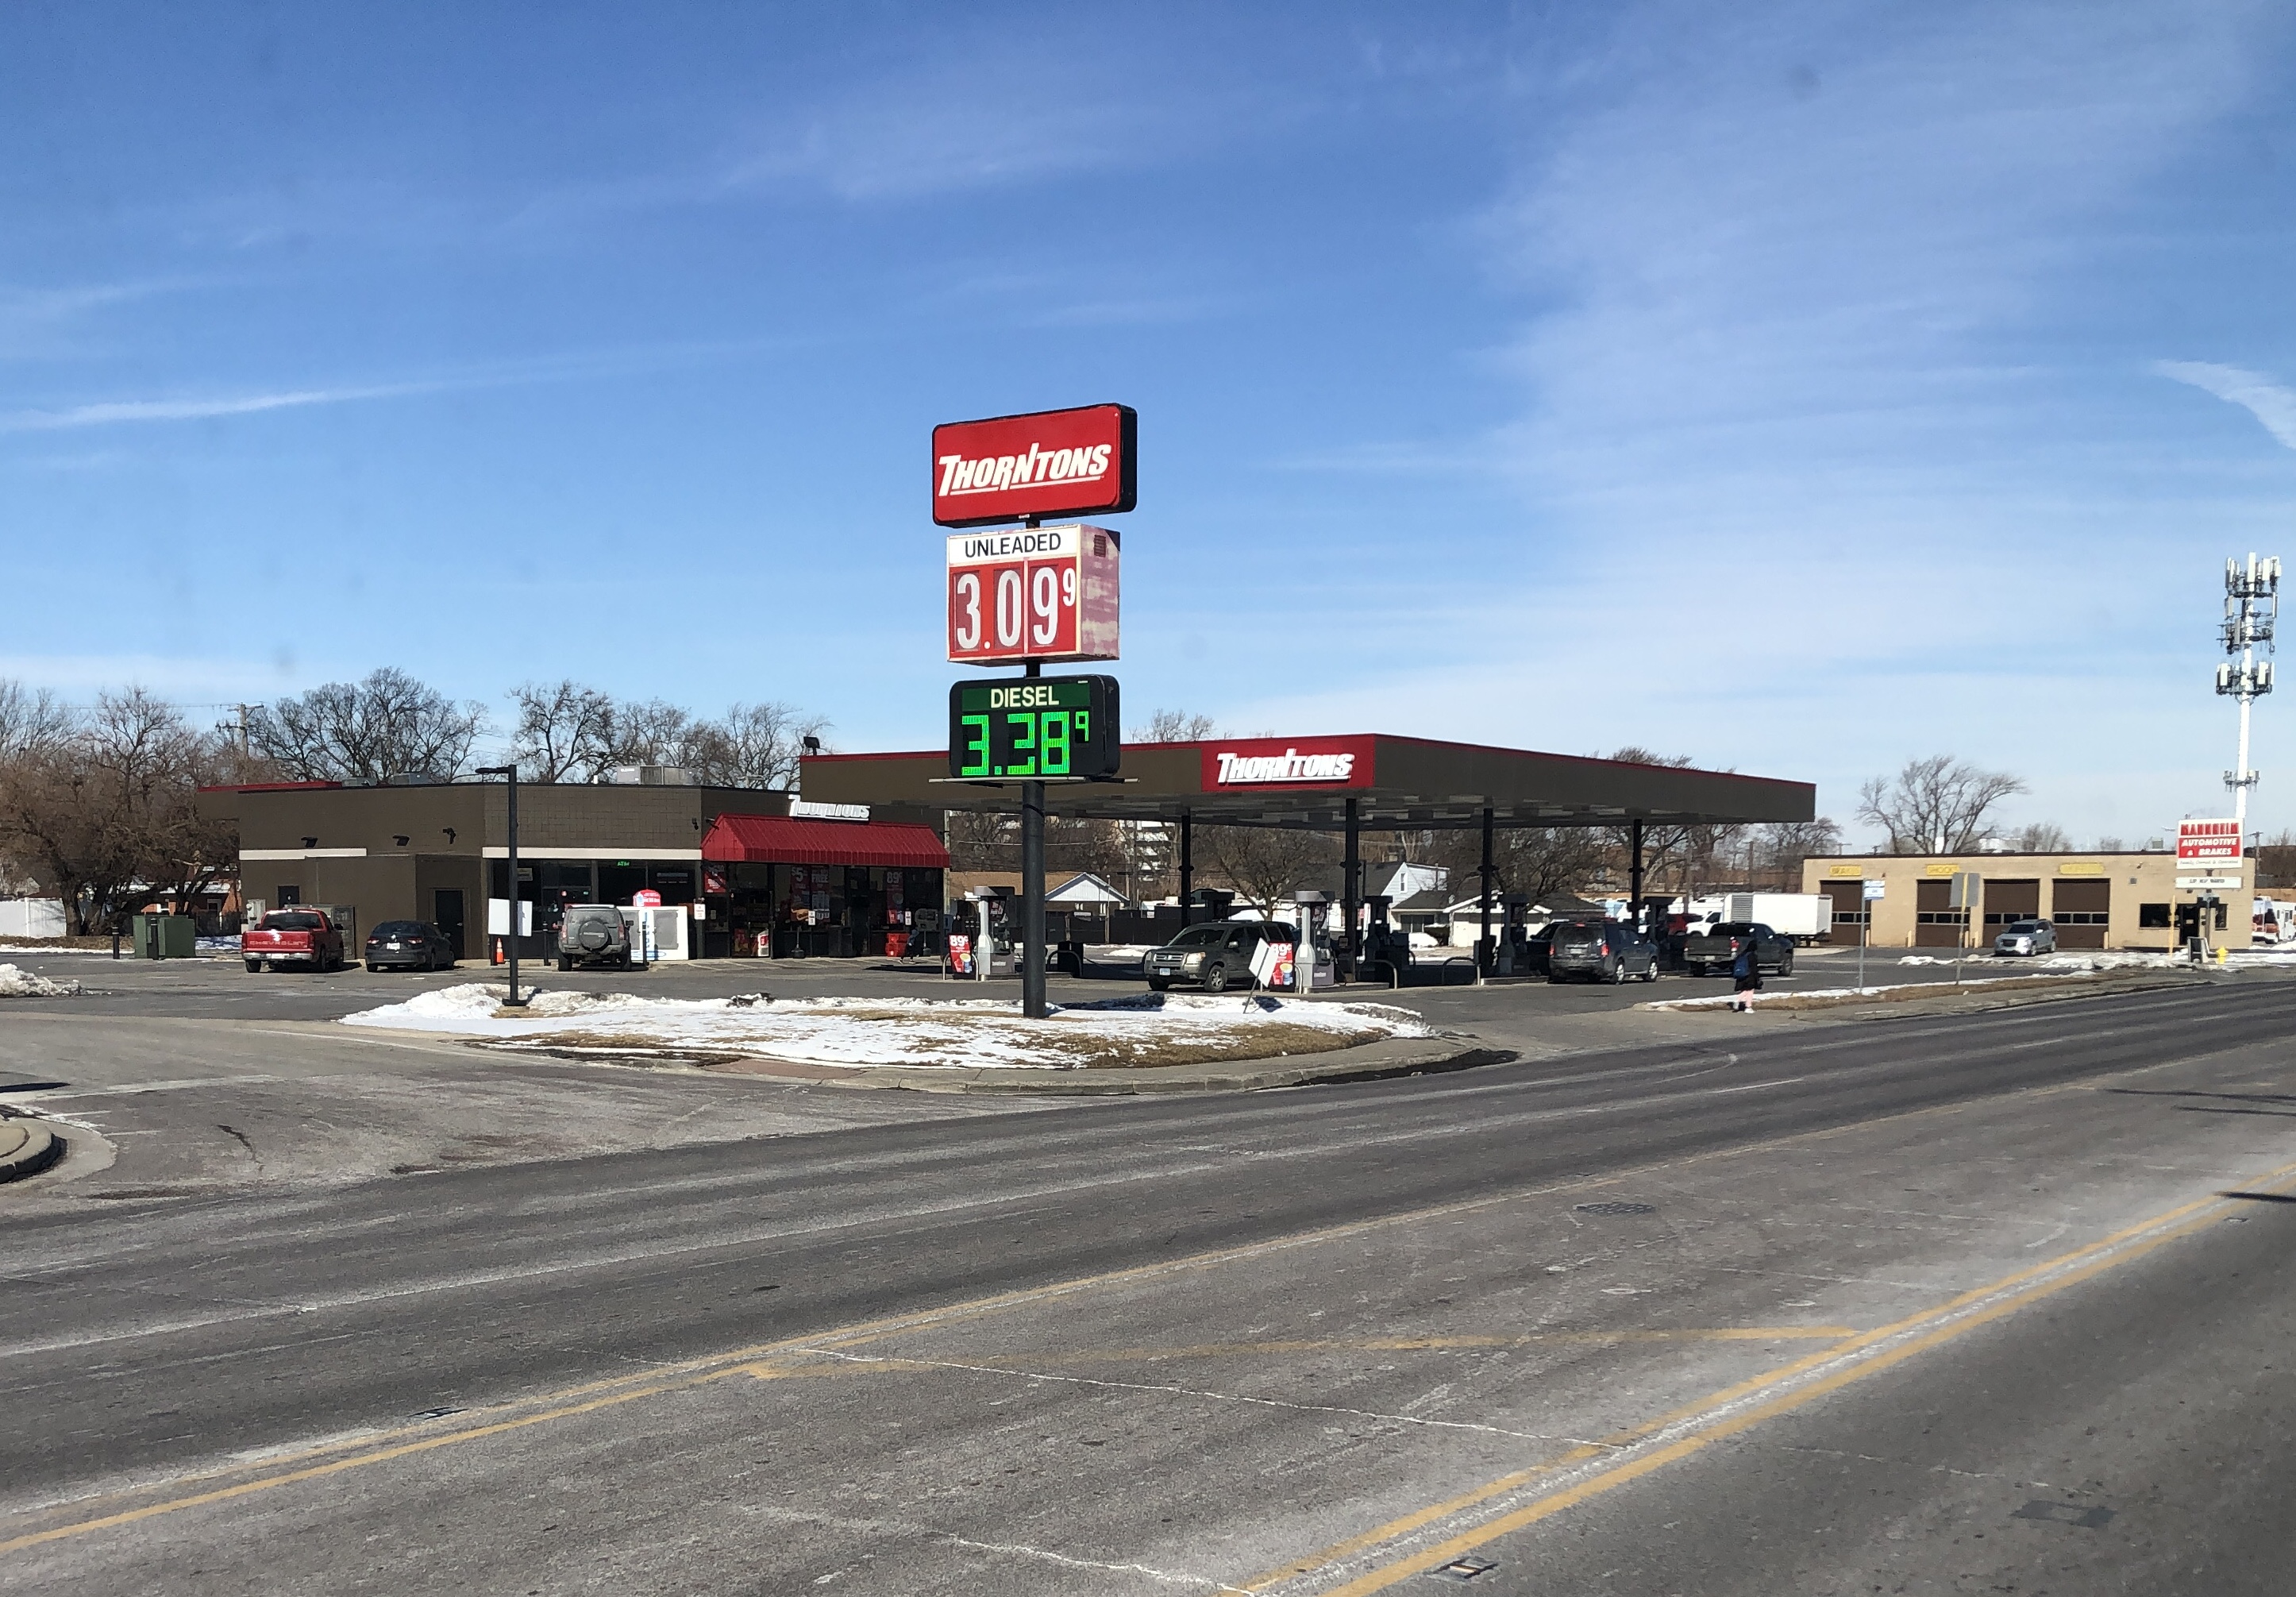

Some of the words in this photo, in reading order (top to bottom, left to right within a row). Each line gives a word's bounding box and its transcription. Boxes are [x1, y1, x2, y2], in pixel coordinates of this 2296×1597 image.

[938, 442, 1111, 496] THORNTONS
[965, 533, 1061, 557] UNLEADED
[990, 685, 1060, 708] DIESEL
[1216, 748, 1355, 784] THORNTONS
[2181, 838, 2238, 847] AUTOMOTIVE
